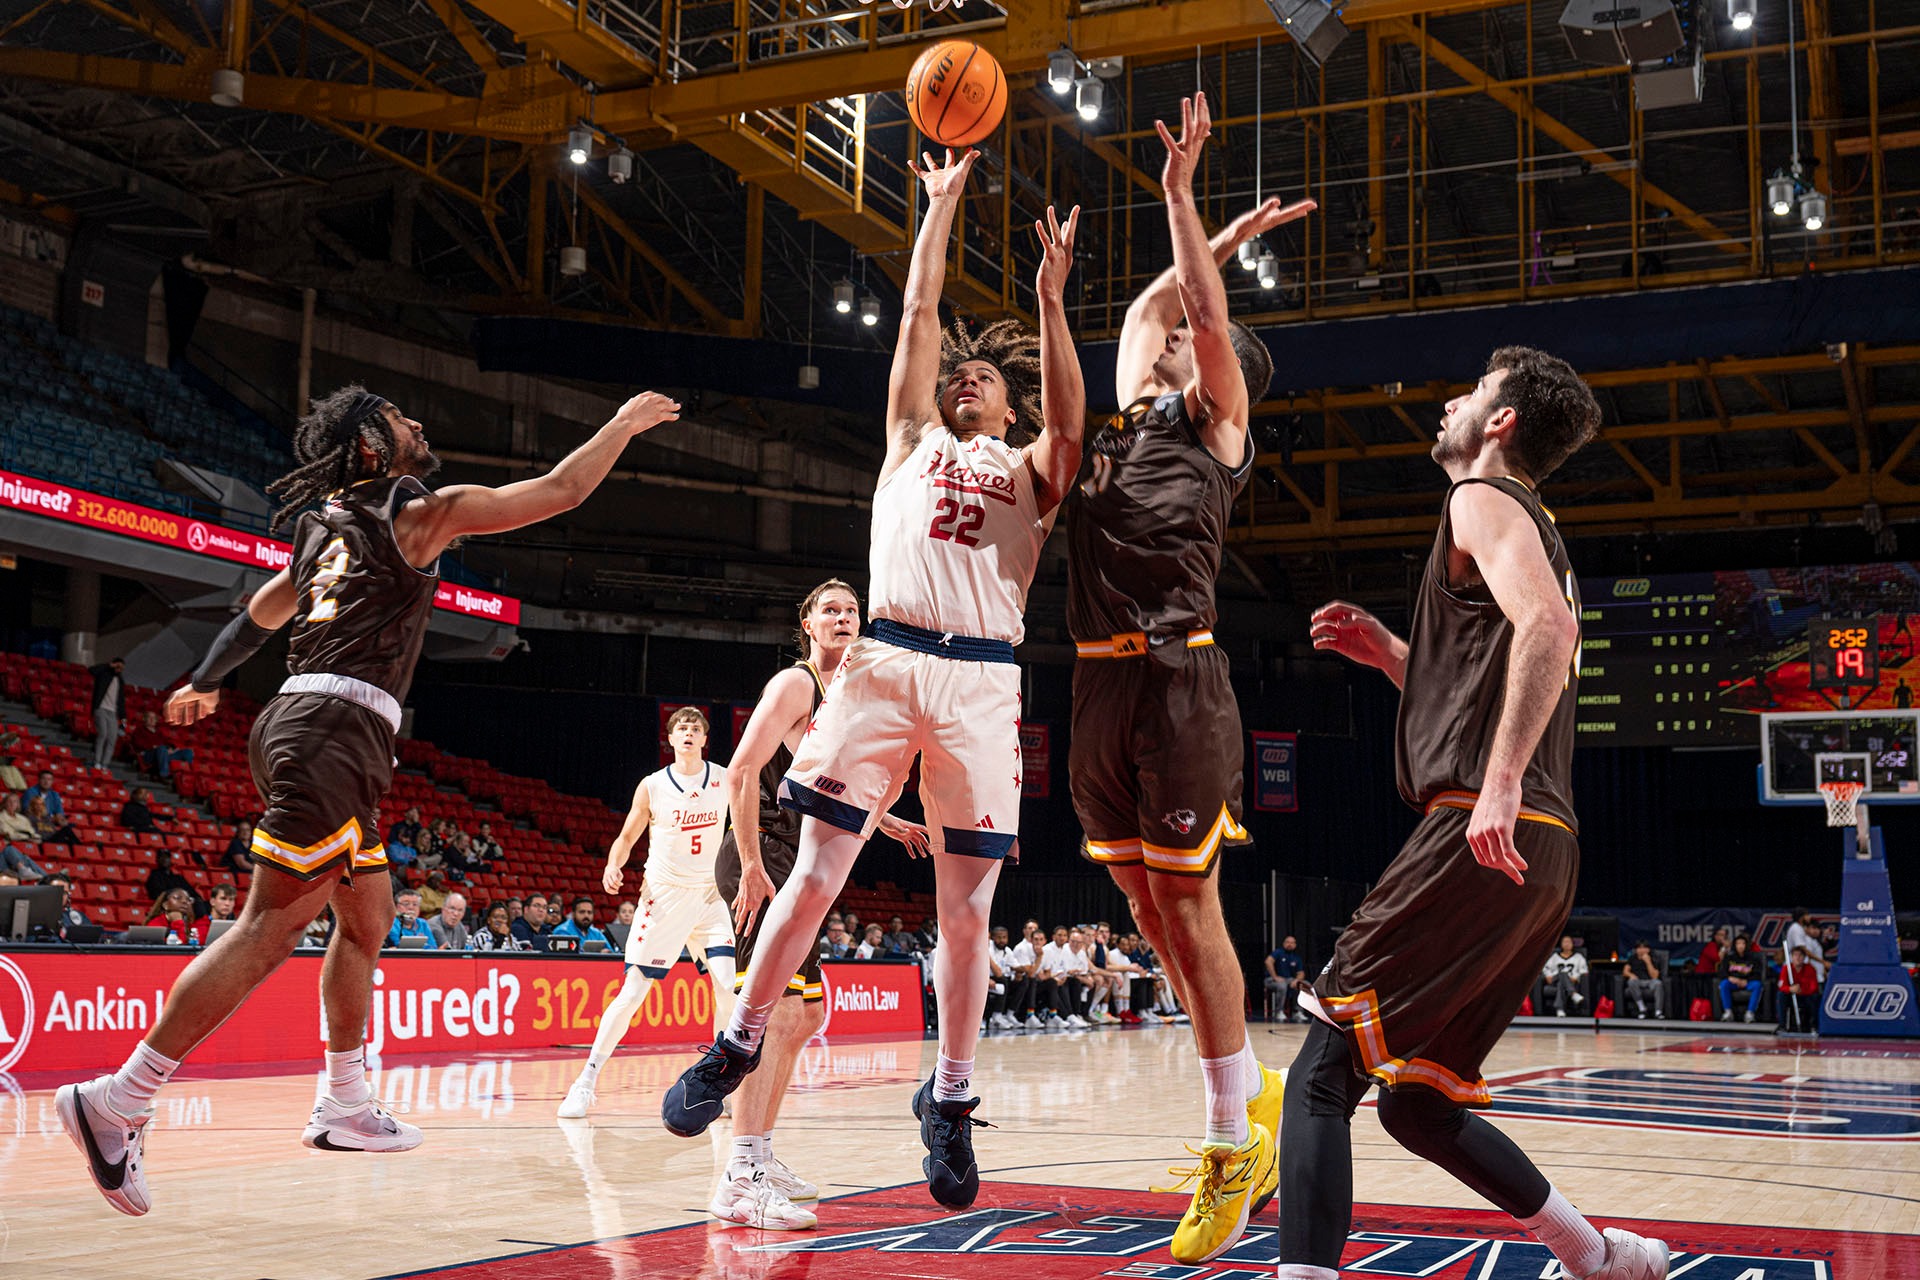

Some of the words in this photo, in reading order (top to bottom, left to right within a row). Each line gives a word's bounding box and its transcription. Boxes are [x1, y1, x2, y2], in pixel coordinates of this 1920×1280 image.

[920, 450, 1016, 496] Flames
[76, 498, 179, 540] 312.600.0000
[929, 497, 986, 547] 22
[209, 534, 232, 550] Ankin
[256, 542, 294, 566] Injur
[307, 537, 350, 622] 2
[456, 590, 503, 615] Injured?
[1684, 606, 1690, 616] 1
[1829, 628, 1868, 648] 2:52
[1654, 664, 1662, 675] 0
[1670, 664, 1679, 674] 0
[1685, 663, 1693, 674] 0
[1836, 648, 1864, 678] 19
[1688, 691, 1693, 702] 1
[814, 774, 846, 796] UIC
[672, 809, 718, 829] Flames
[691, 834, 702, 855] 5
[1658, 924, 1714, 943] HOME
[44, 985, 147, 1032] Ankin
[320, 968, 520, 1055] jured?
[834, 983, 873, 1012] Ankin
[873, 985, 899, 1011] Law
[1826, 985, 1907, 1018] UIC
